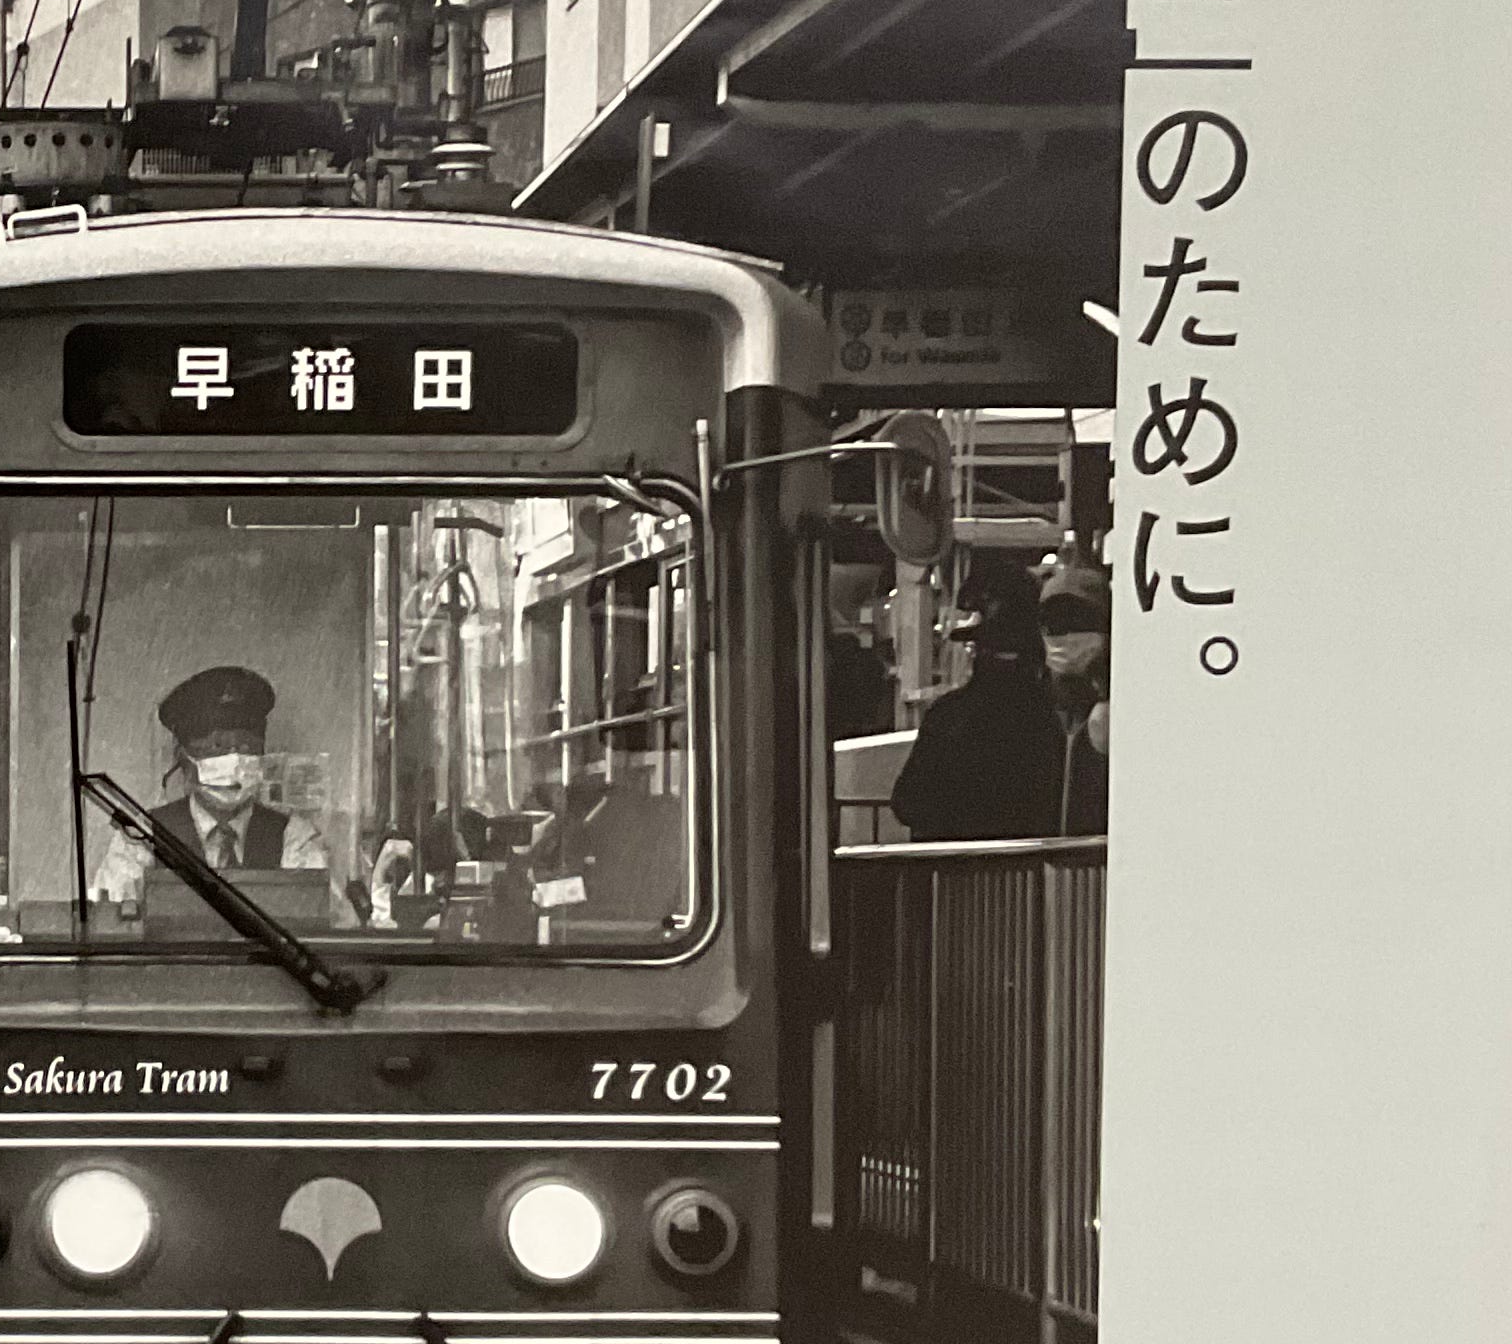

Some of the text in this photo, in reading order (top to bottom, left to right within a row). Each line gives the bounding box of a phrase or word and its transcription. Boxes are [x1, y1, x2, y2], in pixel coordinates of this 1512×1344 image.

[170, 347, 473, 411] 早稲田
[3, 1056, 123, 1095] Sakura
[136, 1061, 230, 1095] Tram
[591, 1063, 731, 1100] 7702
